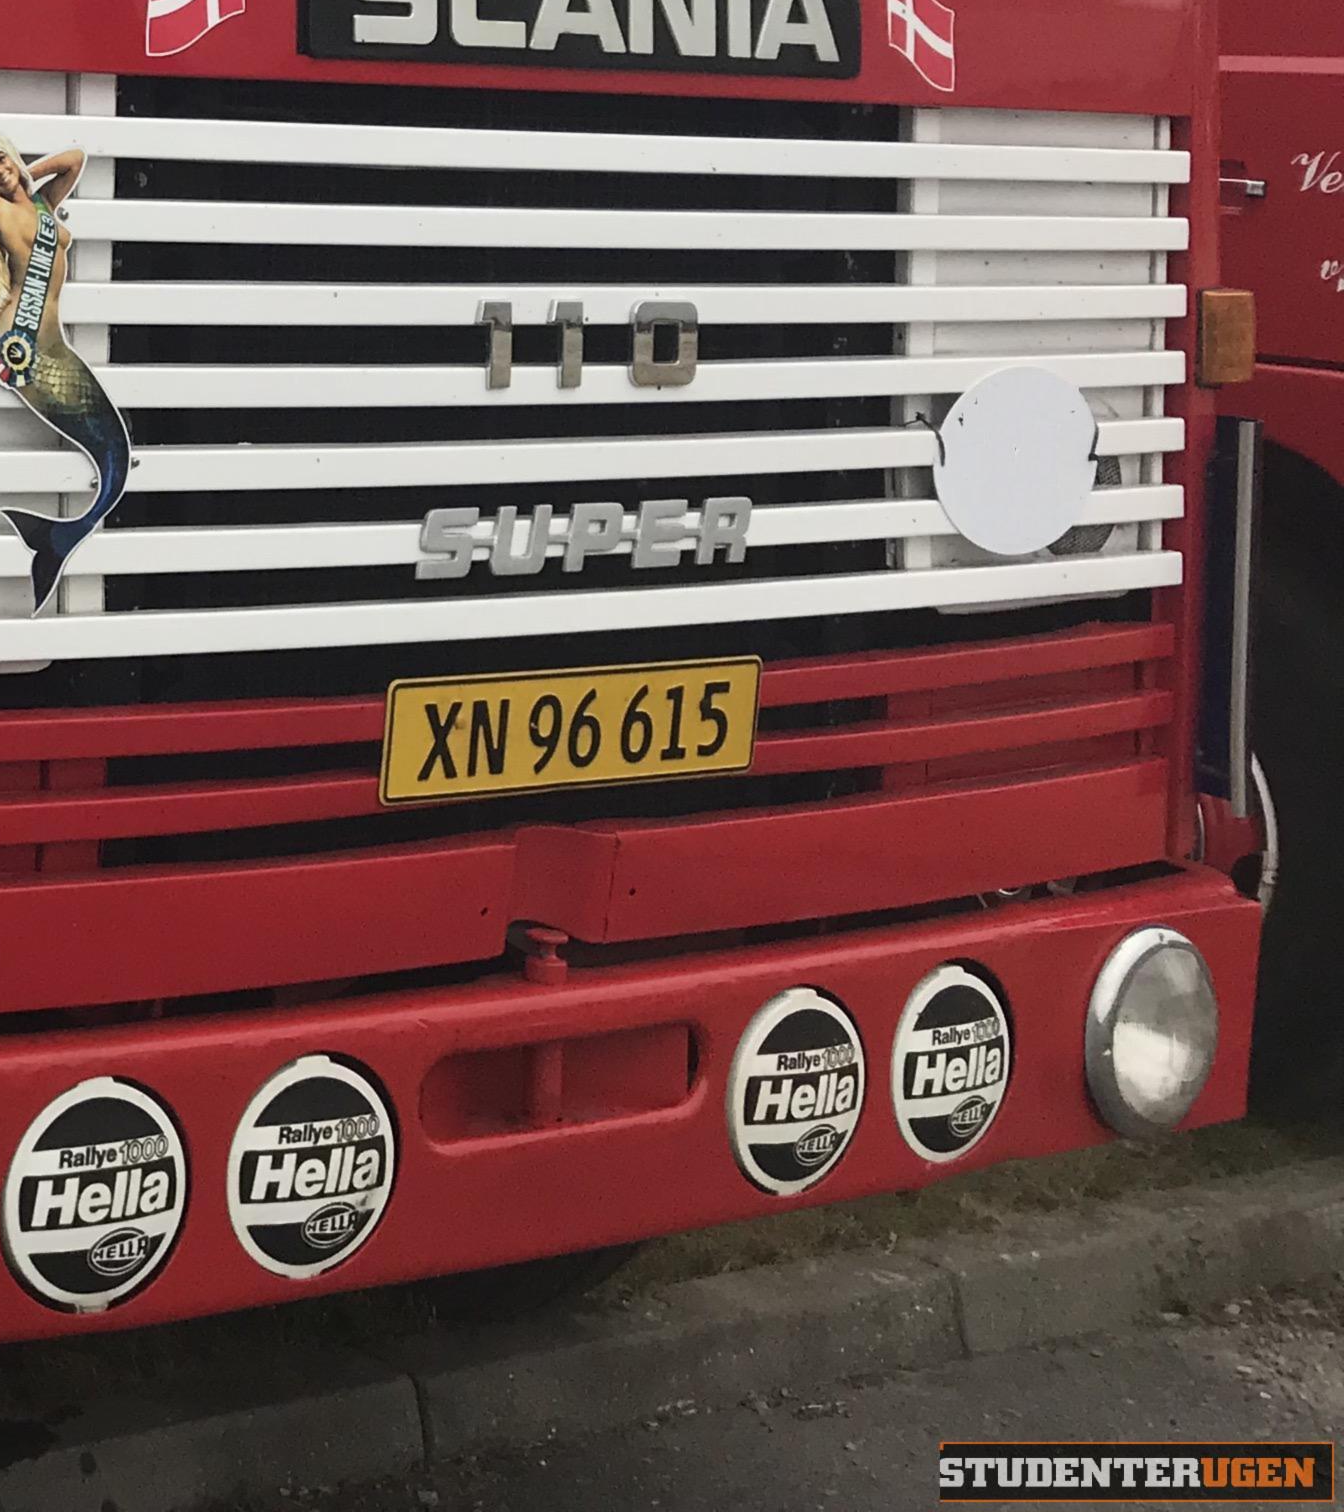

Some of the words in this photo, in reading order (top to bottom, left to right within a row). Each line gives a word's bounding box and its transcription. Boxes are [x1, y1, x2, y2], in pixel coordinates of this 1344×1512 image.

[474, 299, 699, 389] 110
[415, 496, 753, 580] SUPER
[416, 698, 511, 782] XN
[528, 688, 602, 775] 96
[619, 680, 731, 764] 615
[932, 1028, 971, 1047] Rallye
[971, 1016, 1000, 1043] 1000
[776, 1052, 821, 1072] Rallye
[821, 1042, 856, 1071] 1000
[911, 1045, 1001, 1096] Hella
[752, 1072, 856, 1122] Hella
[58, 1144, 118, 1170] Rallye
[118, 1134, 169, 1165] 1000
[278, 1121, 334, 1145] Rallye
[335, 1114, 381, 1141] 1000
[30, 1169, 170, 1228] Hella
[249, 1146, 381, 1201] Hella
[305, 1208, 358, 1234] HELLA
[91, 1233, 150, 1262] HELLA
